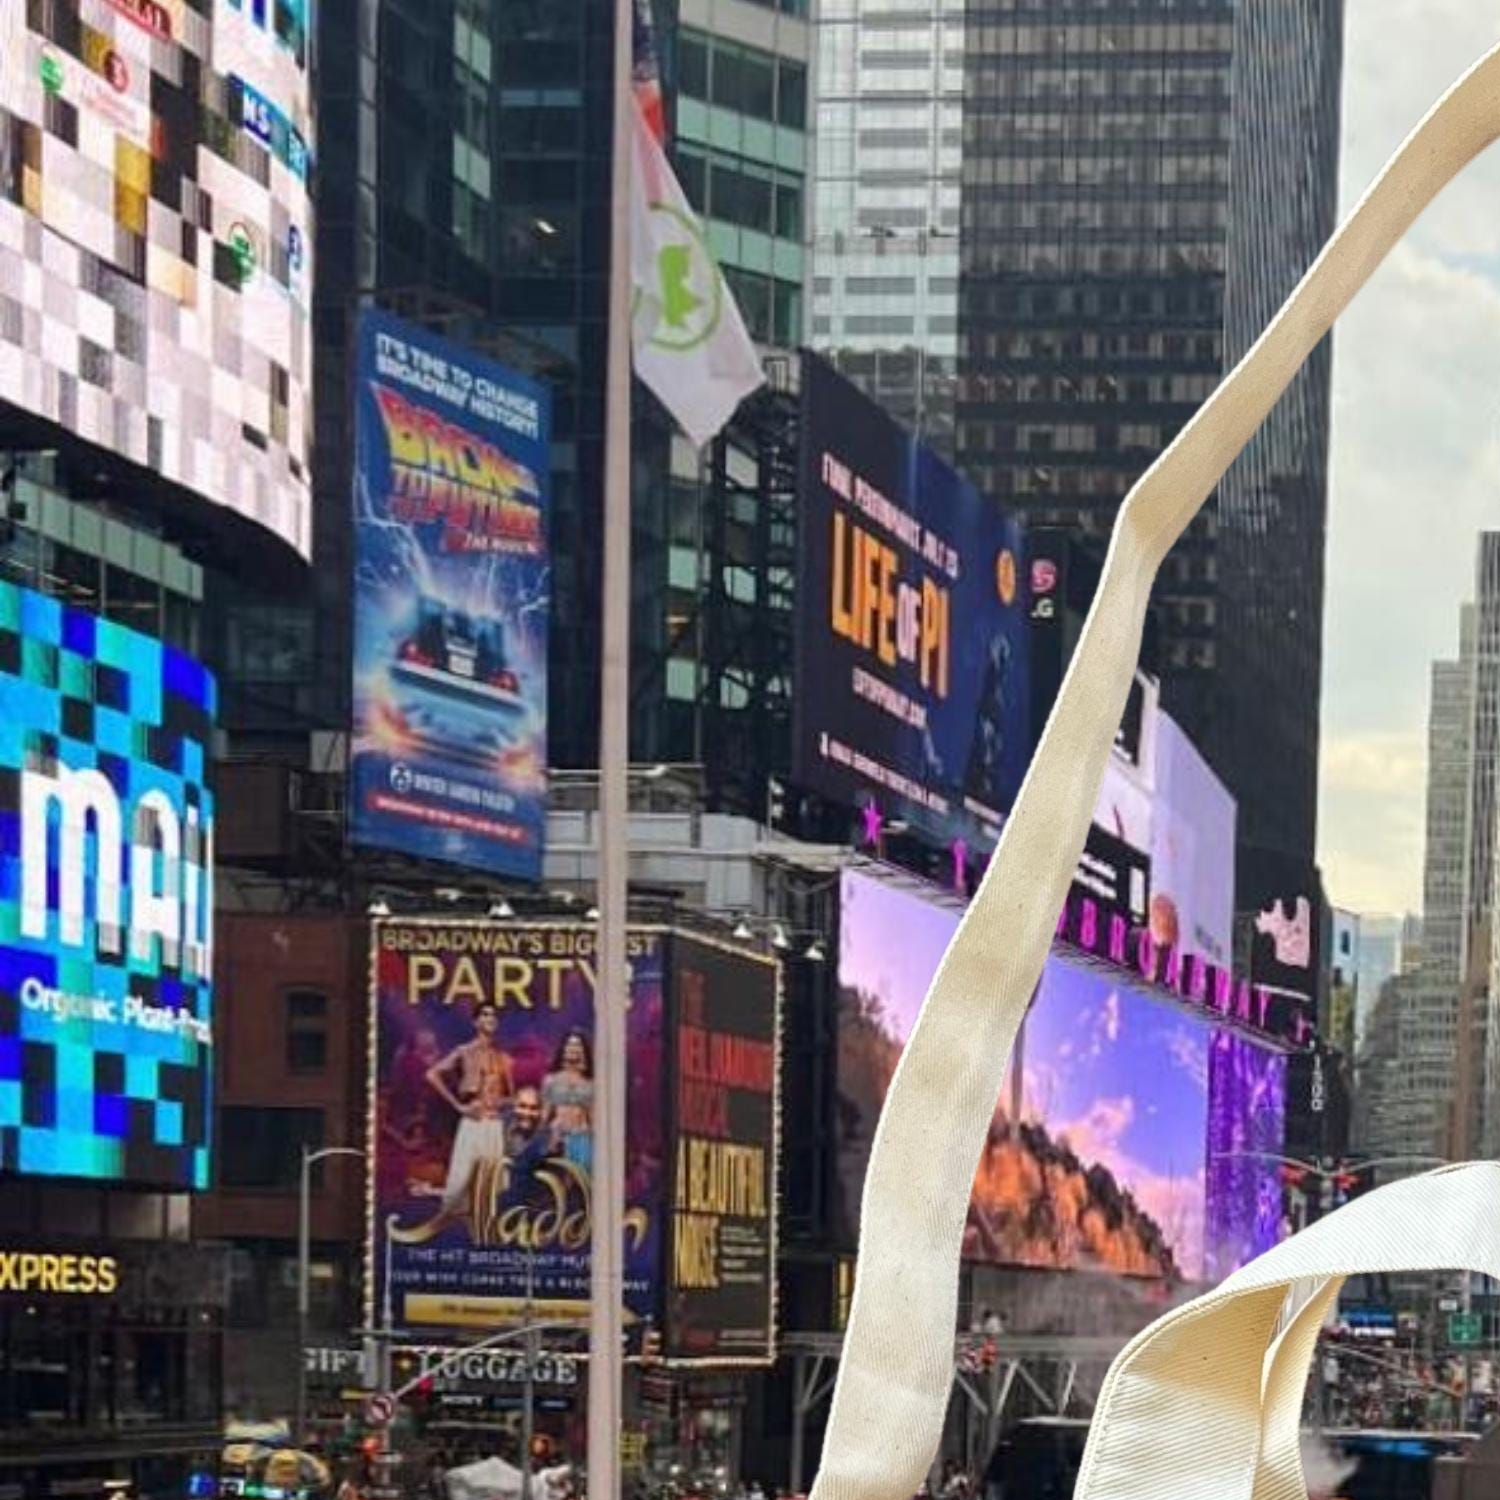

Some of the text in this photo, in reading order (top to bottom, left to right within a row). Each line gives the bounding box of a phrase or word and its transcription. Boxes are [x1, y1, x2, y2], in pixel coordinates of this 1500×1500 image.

[832, 508, 949, 699] LIFE OF PI
[382, 928, 657, 955] BROADWAY'S BIGST
[20, 976, 116, 1022] Organic
[387, 1155, 648, 1251] Aladdn
